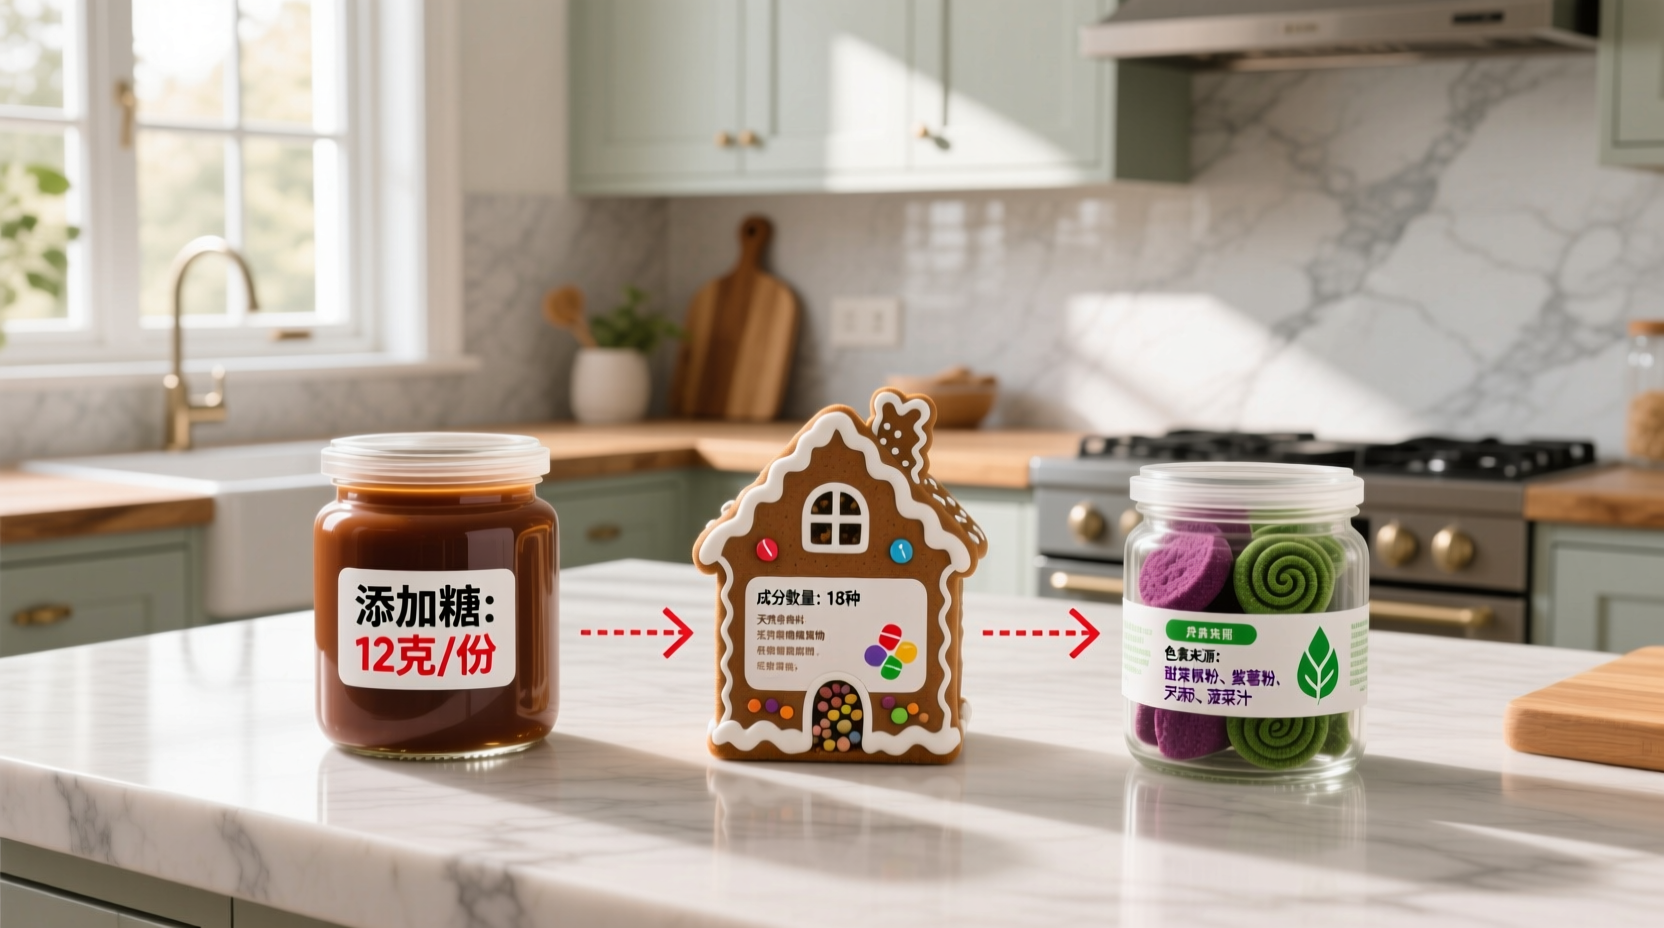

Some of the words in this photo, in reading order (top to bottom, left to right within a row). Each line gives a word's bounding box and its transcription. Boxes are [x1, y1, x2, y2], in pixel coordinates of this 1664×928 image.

[355, 584, 495, 628] 添加糖:
[827, 589, 861, 607] 18种
[355, 633, 497, 677] 12克/份
